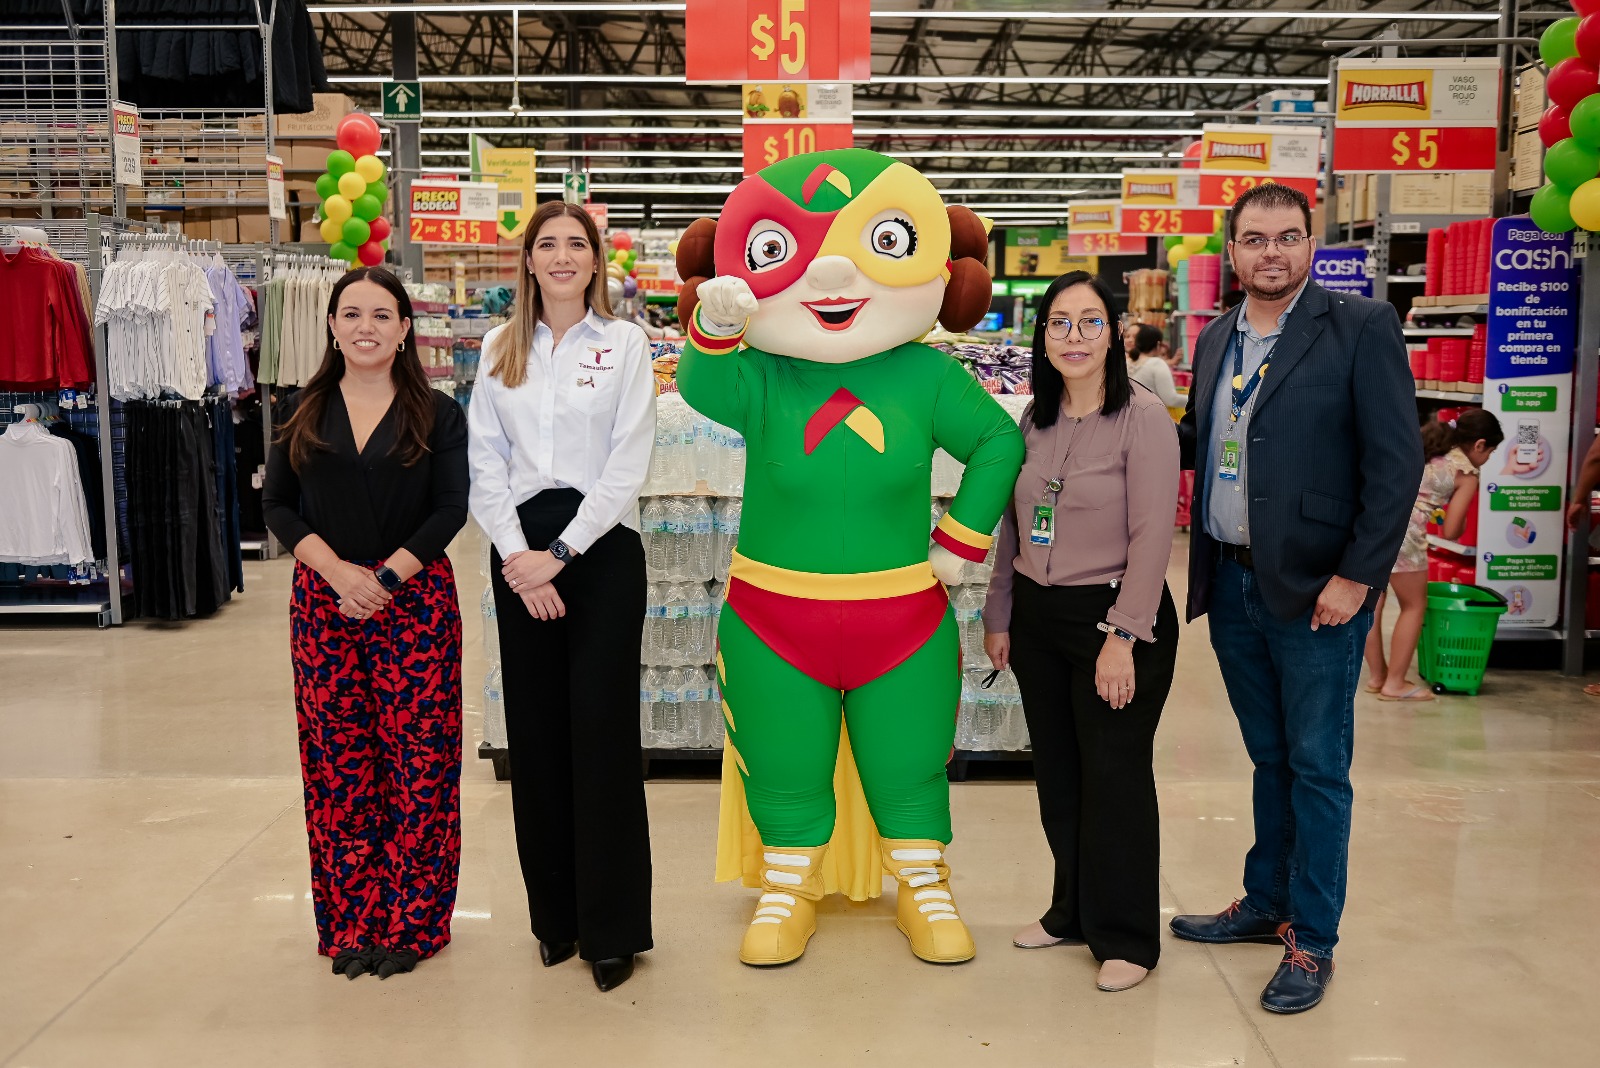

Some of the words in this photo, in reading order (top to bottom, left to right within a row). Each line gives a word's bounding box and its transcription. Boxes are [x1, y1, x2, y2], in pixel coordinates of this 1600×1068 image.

[751, 0, 806, 75] $5
[1351, 84, 1420, 103] MORRALLA
[1453, 92, 1476, 100] ROJO
[116, 114, 135, 125] PRECIO
[764, 127, 816, 165] $10
[1211, 142, 1264, 158] MORRALLA
[1391, 129, 1439, 169] $5
[486, 160, 530, 168] Verificador
[1130, 183, 1171, 195] MORRALLA
[413, 191, 459, 202] PRECIO
[413, 201, 457, 211] BODEGA
[1138, 210, 1182, 233] $25
[411, 218, 424, 241] 2
[425, 226, 437, 234] por
[441, 220, 481, 243] $55
[1508, 229, 1540, 242] Paga
[1541, 231, 1565, 241] con
[101, 235, 110, 247] M
[1083, 232, 1119, 253] $35
[1573, 242, 1586, 254] 11
[1314, 257, 1366, 276] cash
[1497, 282, 1538, 292] Recibe
[1540, 282, 1570, 292] $100
[1525, 294, 1540, 304] de
[1495, 306, 1568, 316] bonificación
[1516, 320, 1532, 328] en
[1533, 319, 1547, 328] tu
[1507, 330, 1554, 342] primera
[1498, 344, 1544, 354] compra
[1546, 344, 1561, 352] en
[1510, 355, 1548, 365] tienda
[578, 362, 614, 371] Tamaulipas
[1500, 384, 1506, 393] 1
[1511, 390, 1547, 398] Descarga
[1489, 484, 1496, 493] 2
[1500, 488, 1526, 496] Agrega
[1485, 553, 1492, 563] 3
